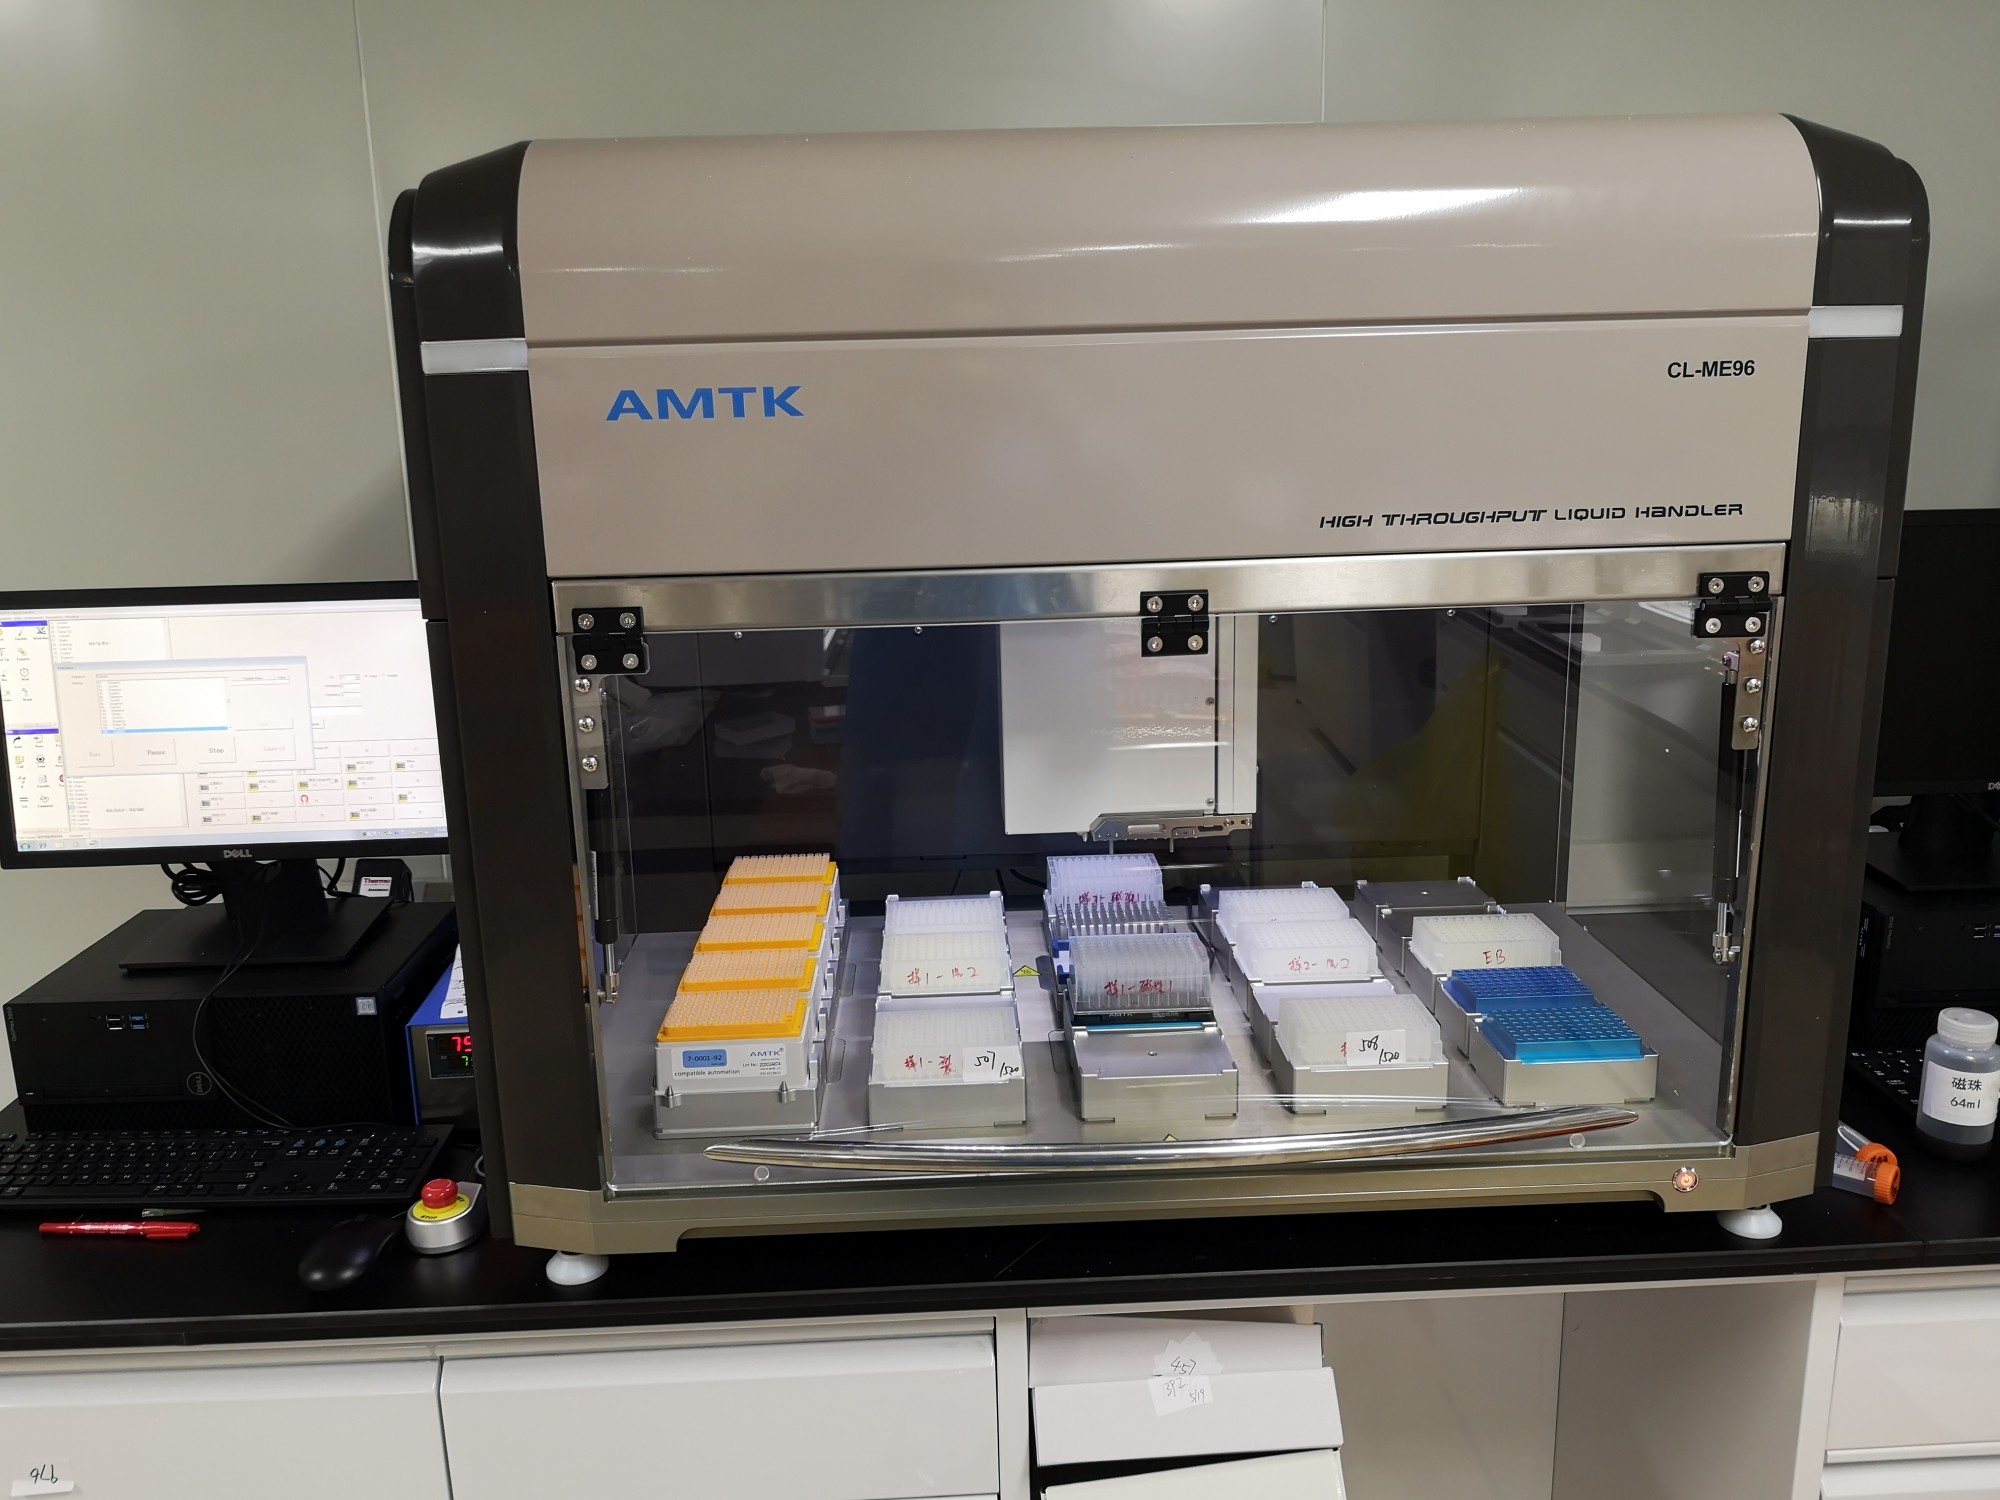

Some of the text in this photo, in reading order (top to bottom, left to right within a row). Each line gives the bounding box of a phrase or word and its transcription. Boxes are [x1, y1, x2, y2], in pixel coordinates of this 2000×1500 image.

[1667, 359, 1756, 379] CL-ME96
[606, 386, 805, 422] AMTK
[1319, 514, 1374, 529] HIGH
[1381, 509, 1548, 527] THROUGHPUT
[1554, 507, 1626, 522] LIQUID
[208, 747, 225, 755] Stop
[223, 849, 253, 859] DELL
[1482, 948, 1506, 965] EB
[687, 1054, 722, 1062] 7-0001-92
[974, 1050, 996, 1070] 507
[674, 1068, 741, 1077] compatible automation
[1951, 1076, 1983, 1091] 磁珠
[1950, 1096, 1981, 1109] 64ml
[1170, 1355, 1197, 1376] 457
